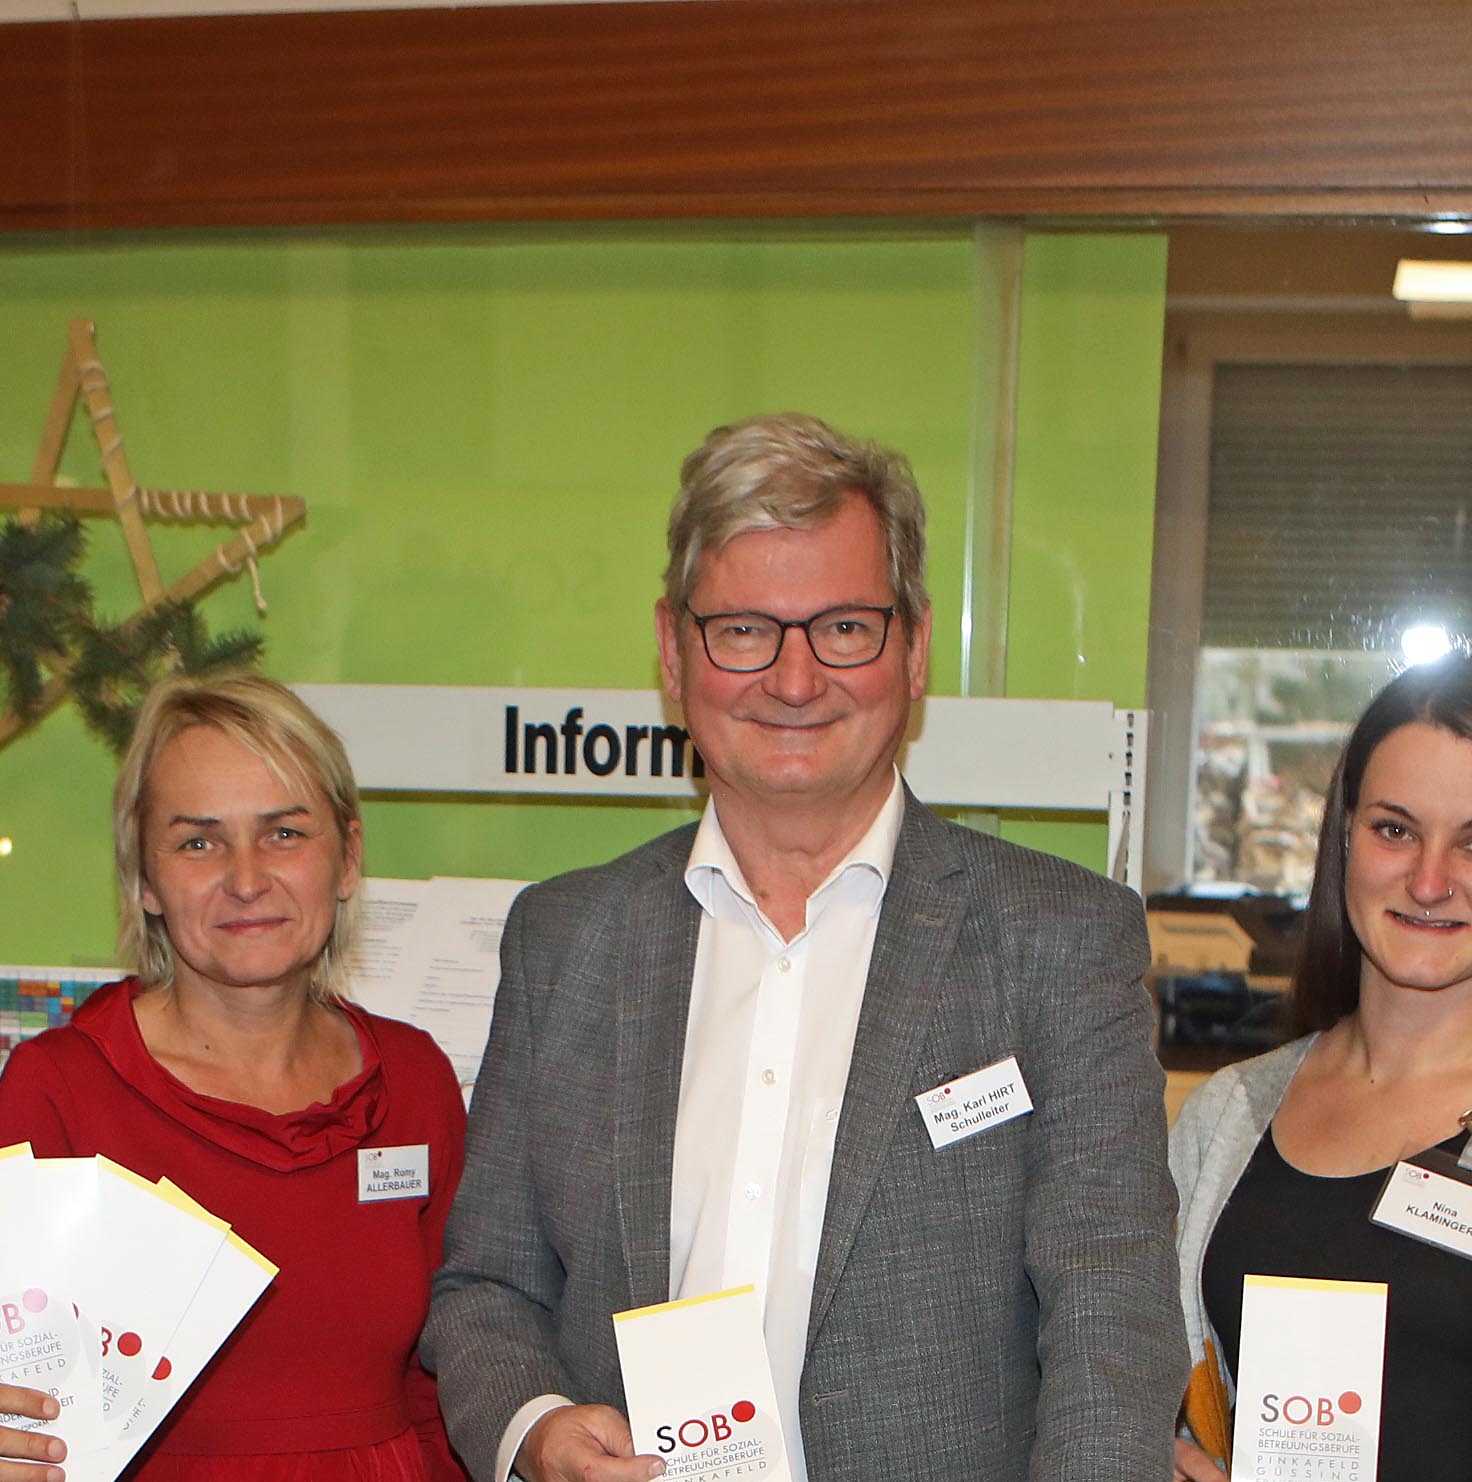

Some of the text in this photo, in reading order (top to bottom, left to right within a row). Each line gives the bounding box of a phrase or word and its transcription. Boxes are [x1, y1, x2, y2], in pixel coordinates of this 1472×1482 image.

[934, 1083, 1016, 1124] Mag. Karl HIRT
[950, 1102, 1010, 1132] Schulleiter
[394, 1168, 416, 1178] Romy
[367, 1179, 422, 1192] ALLERBAUER
[1433, 1202, 1458, 1217] Nina
[17, 1331, 59, 1348] SOZIAL-
[1261, 1394, 1335, 1426] SOB
[656, 1414, 732, 1453] SOB
[1258, 1427, 1296, 1438] SCHULE
[1321, 1432, 1360, 1442] SOZIAL-
[666, 1438, 763, 1467] CHULE FÜR SOZIAL-
[1258, 1439, 1360, 1454] BETREUUNGSBERUFE
[662, 1447, 765, 1478] BETREUUNGSBERUFE
[1257, 1455, 1359, 1470] PINKAFELD
